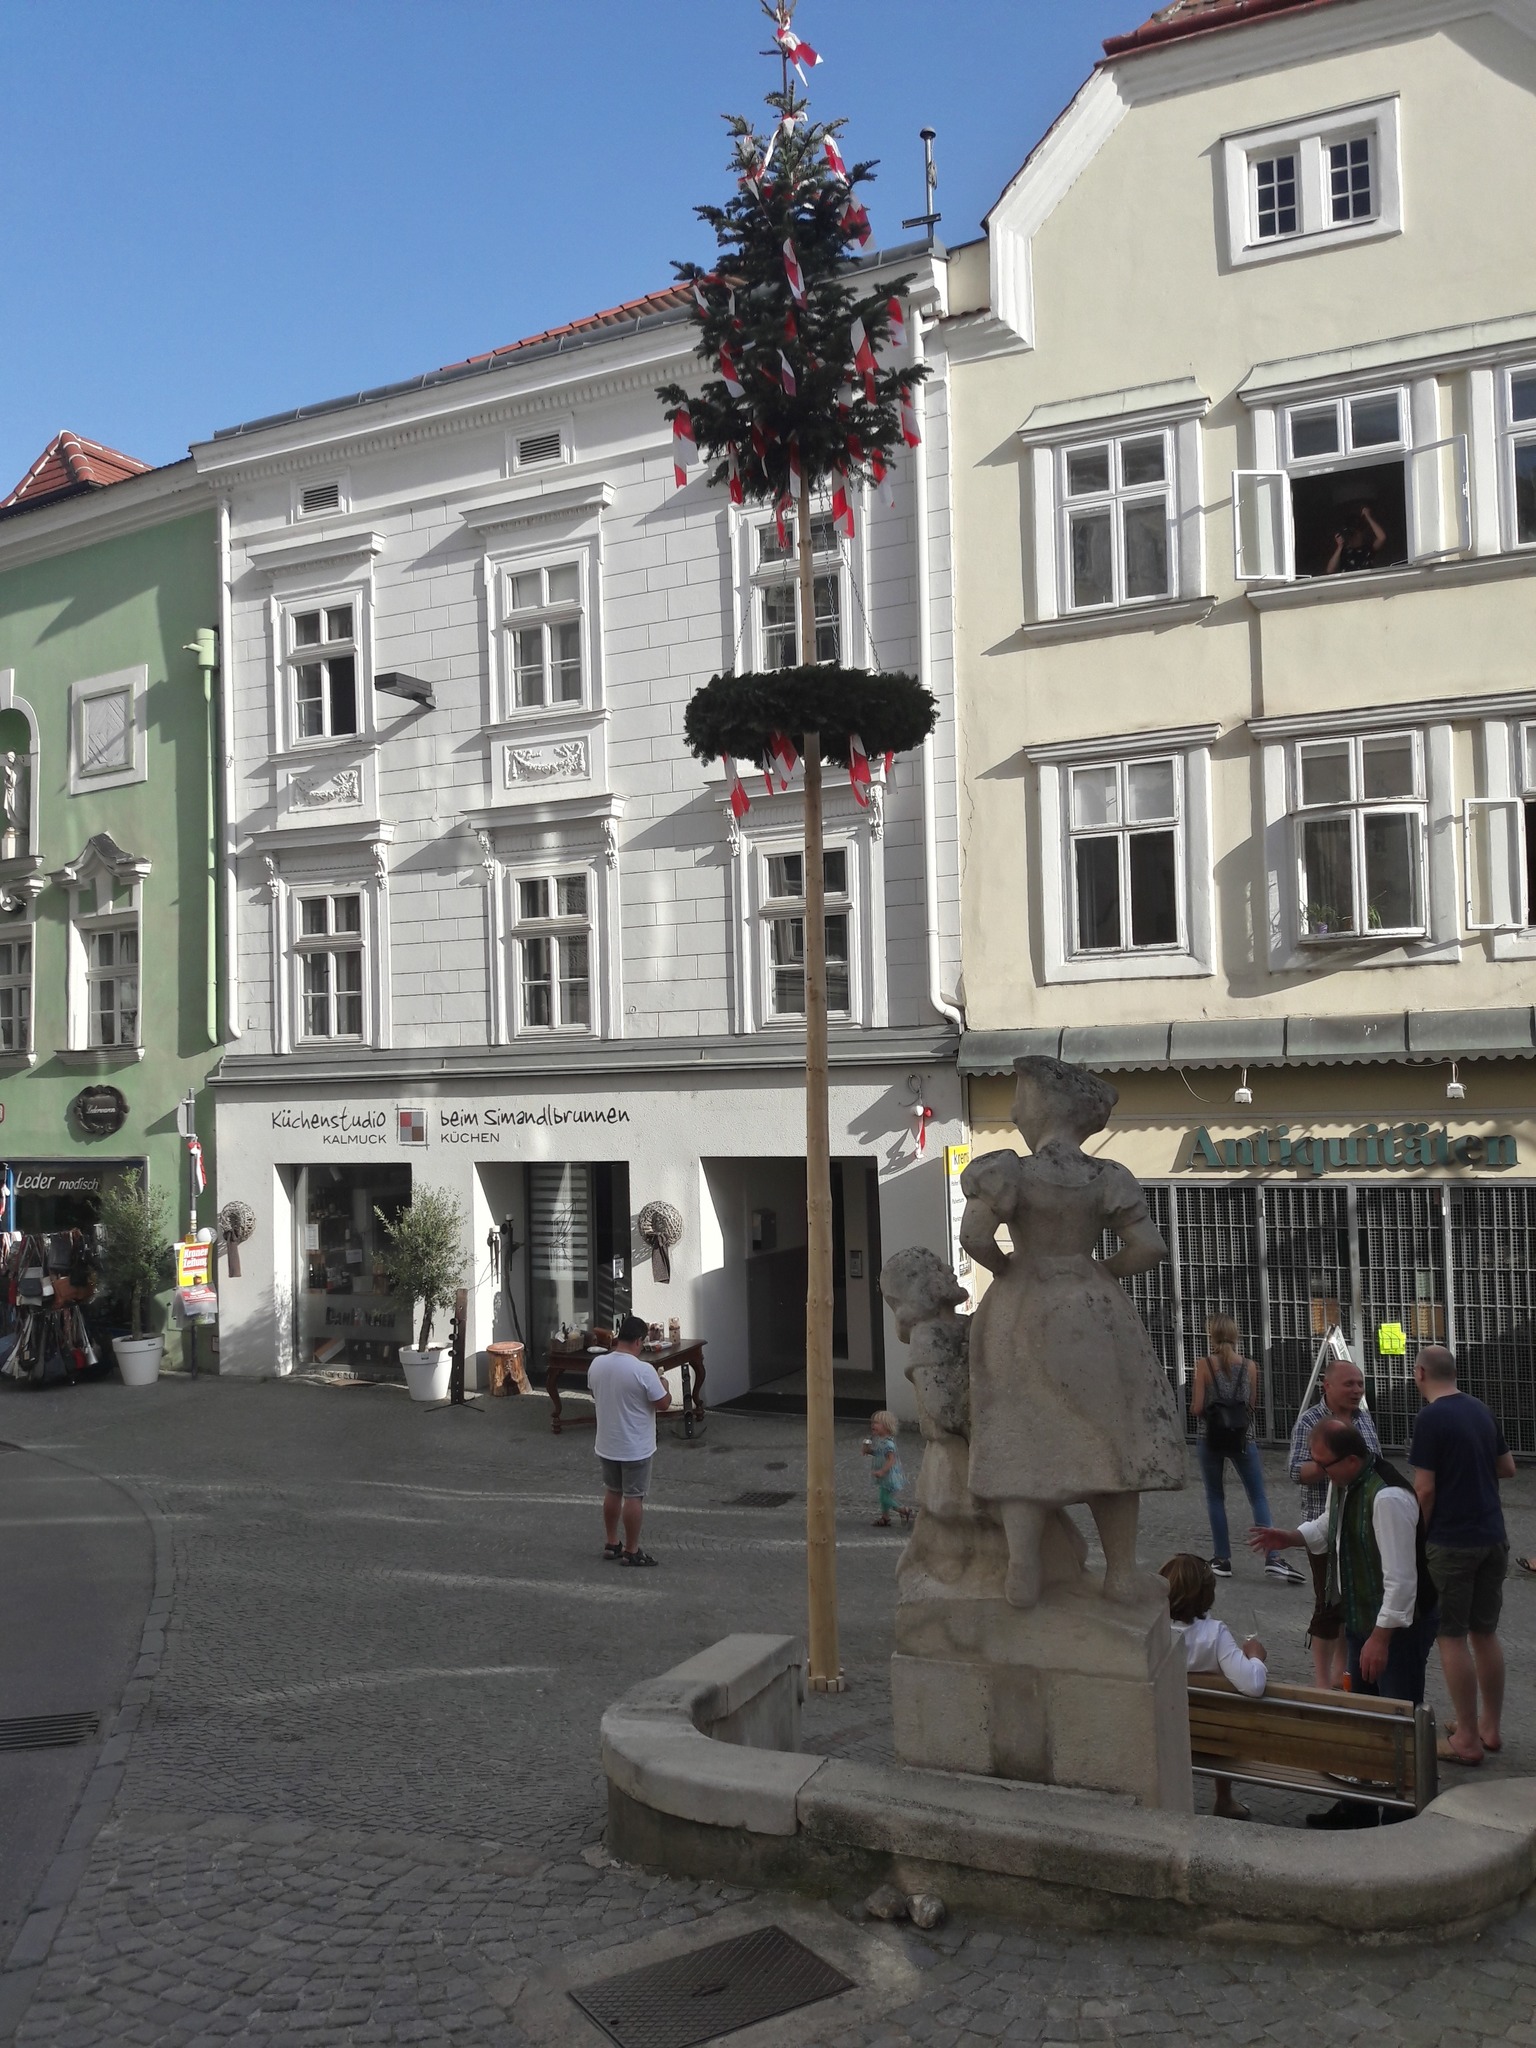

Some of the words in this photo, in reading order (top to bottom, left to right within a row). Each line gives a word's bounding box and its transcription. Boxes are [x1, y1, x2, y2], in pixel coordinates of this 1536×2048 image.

[271, 1105, 387, 1132] Küchenstudio
[440, 1106, 479, 1127] beim
[484, 1103, 631, 1126] Simandlbrunnen
[322, 1133, 387, 1145] KALMUCK
[440, 1131, 500, 1144] KÜCHEN
[1186, 1121, 1521, 1174] Antiquitäten
[16, 1171, 55, 1190] Leder
[58, 1177, 99, 1191] modisch
